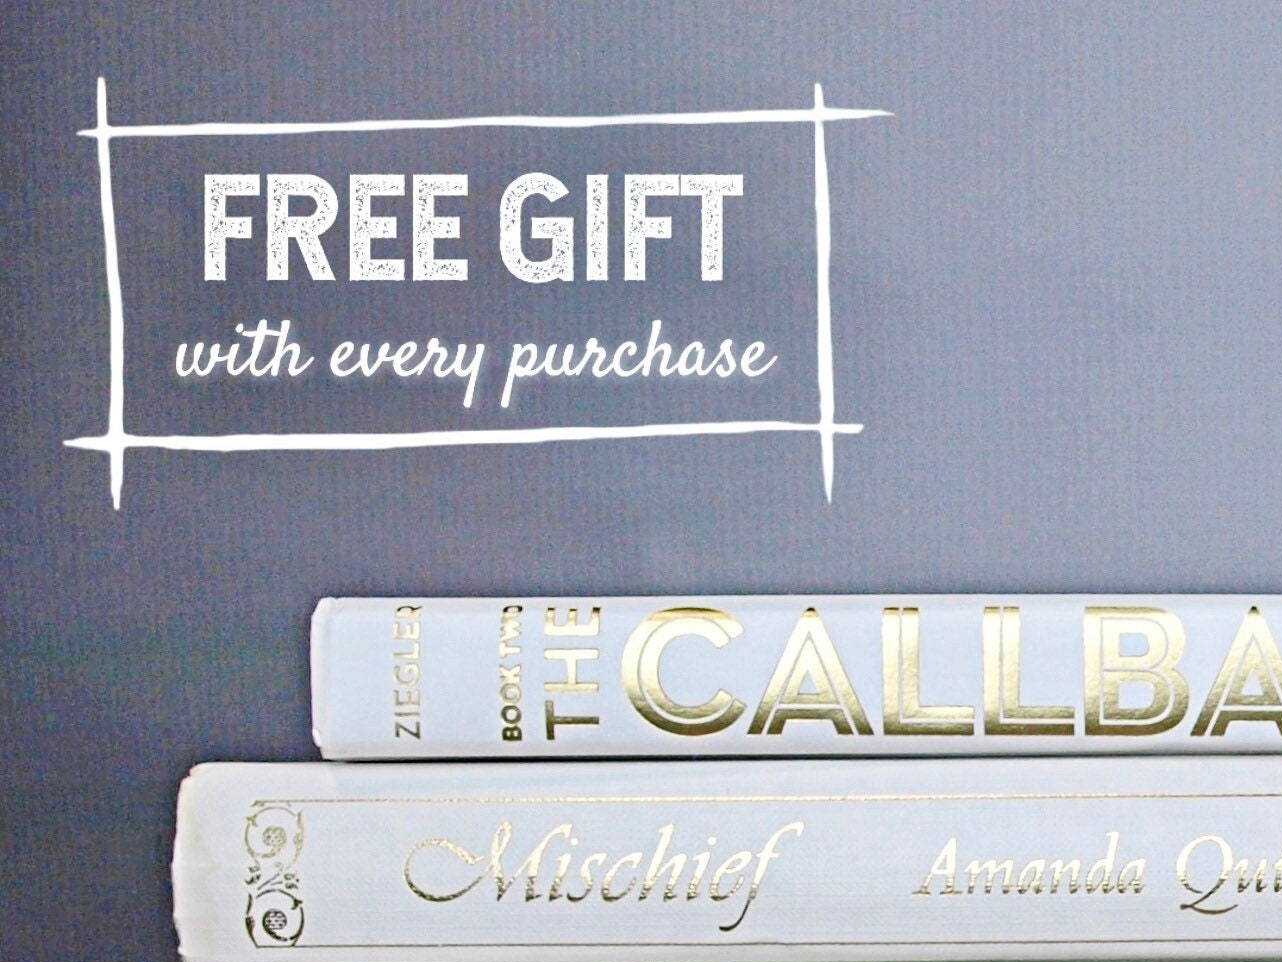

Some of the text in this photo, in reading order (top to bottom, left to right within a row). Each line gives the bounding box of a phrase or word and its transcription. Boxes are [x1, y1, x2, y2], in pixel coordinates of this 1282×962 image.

[393, 604, 421, 741] ZIEGLER
[500, 604, 523, 742] BOOK TWO
[544, 605, 600, 740] THE
[404, 819, 804, 932] Mischief
[912, 831, 1147, 896] Amanda
